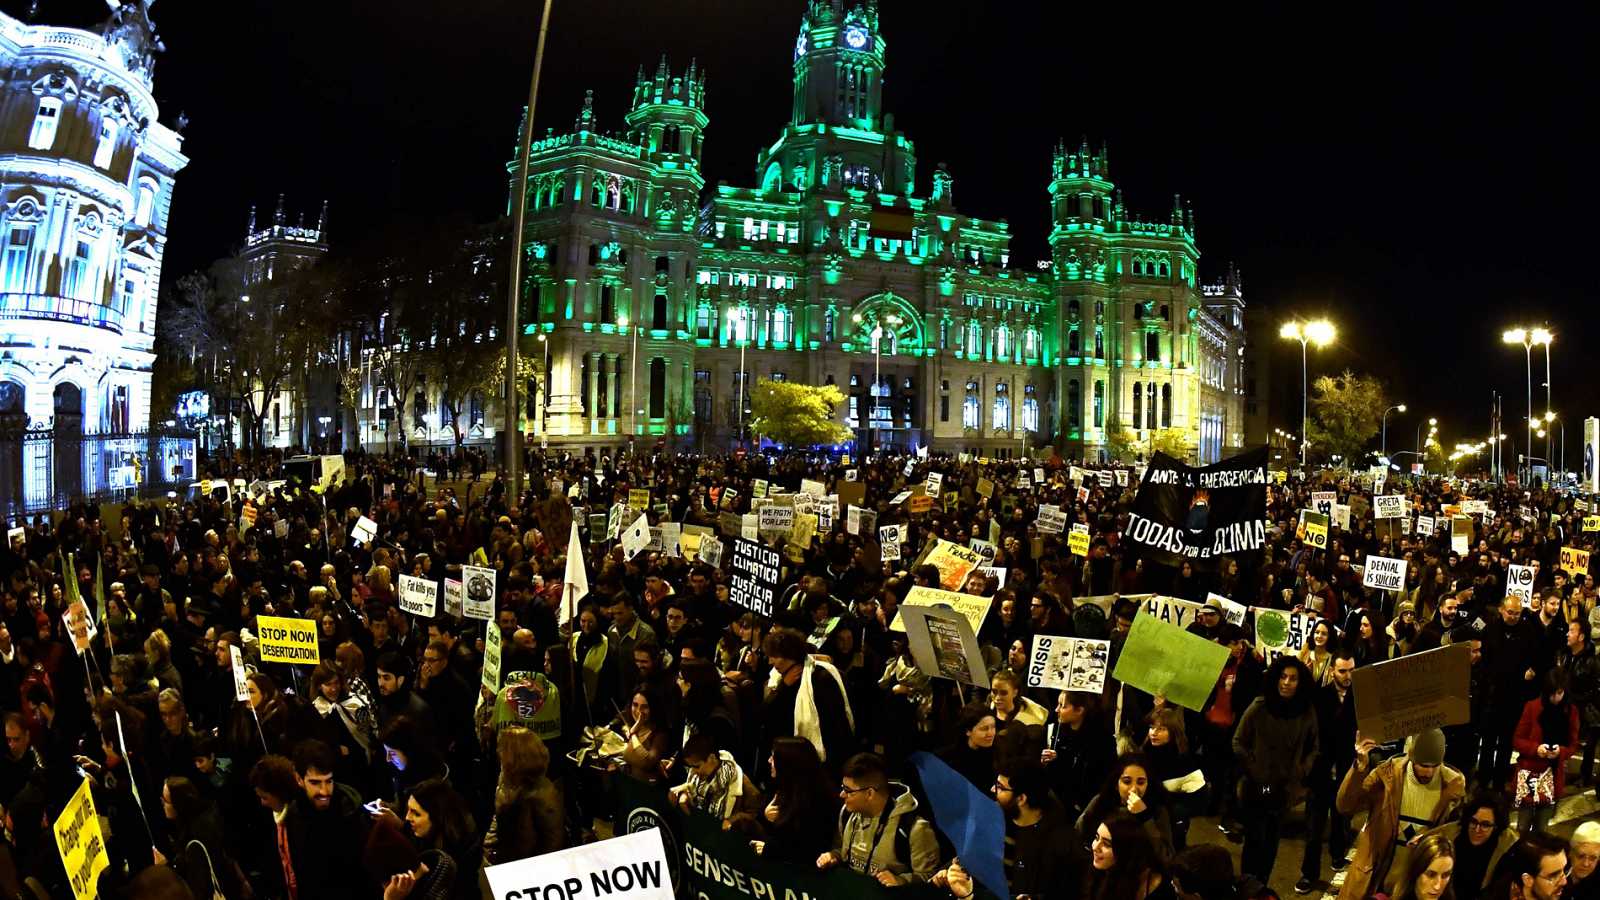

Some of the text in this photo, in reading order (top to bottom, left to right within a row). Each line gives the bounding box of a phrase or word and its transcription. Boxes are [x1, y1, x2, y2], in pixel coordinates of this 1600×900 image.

[1150, 470, 1178, 484] ANTE
[1378, 498, 1400, 506] GRETA
[1125, 512, 1184, 554] TODAS
[1183, 545, 1198, 558] POR
[1200, 547, 1210, 558] EL
[735, 540, 779, 568] JUSTICIA
[1371, 560, 1398, 574] DENIAL
[734, 554, 778, 584] CLIMATICA
[1376, 574, 1400, 586] SUICIDE
[407, 580, 416, 592] Fat
[416, 582, 426, 594] kills
[426, 586, 436, 598] you
[730, 587, 773, 618] SOCIAL!
[732, 575, 773, 604] JUSTICIA
[1148, 599, 1187, 627] HAY
[1290, 614, 1301, 632] EL
[261, 627, 314, 643] STOP NOW
[262, 643, 318, 660] DESERTIZATION!
[1028, 638, 1052, 687] CRISIS
[590, 860, 660, 898] NOW
[686, 842, 750, 894] SENSE
